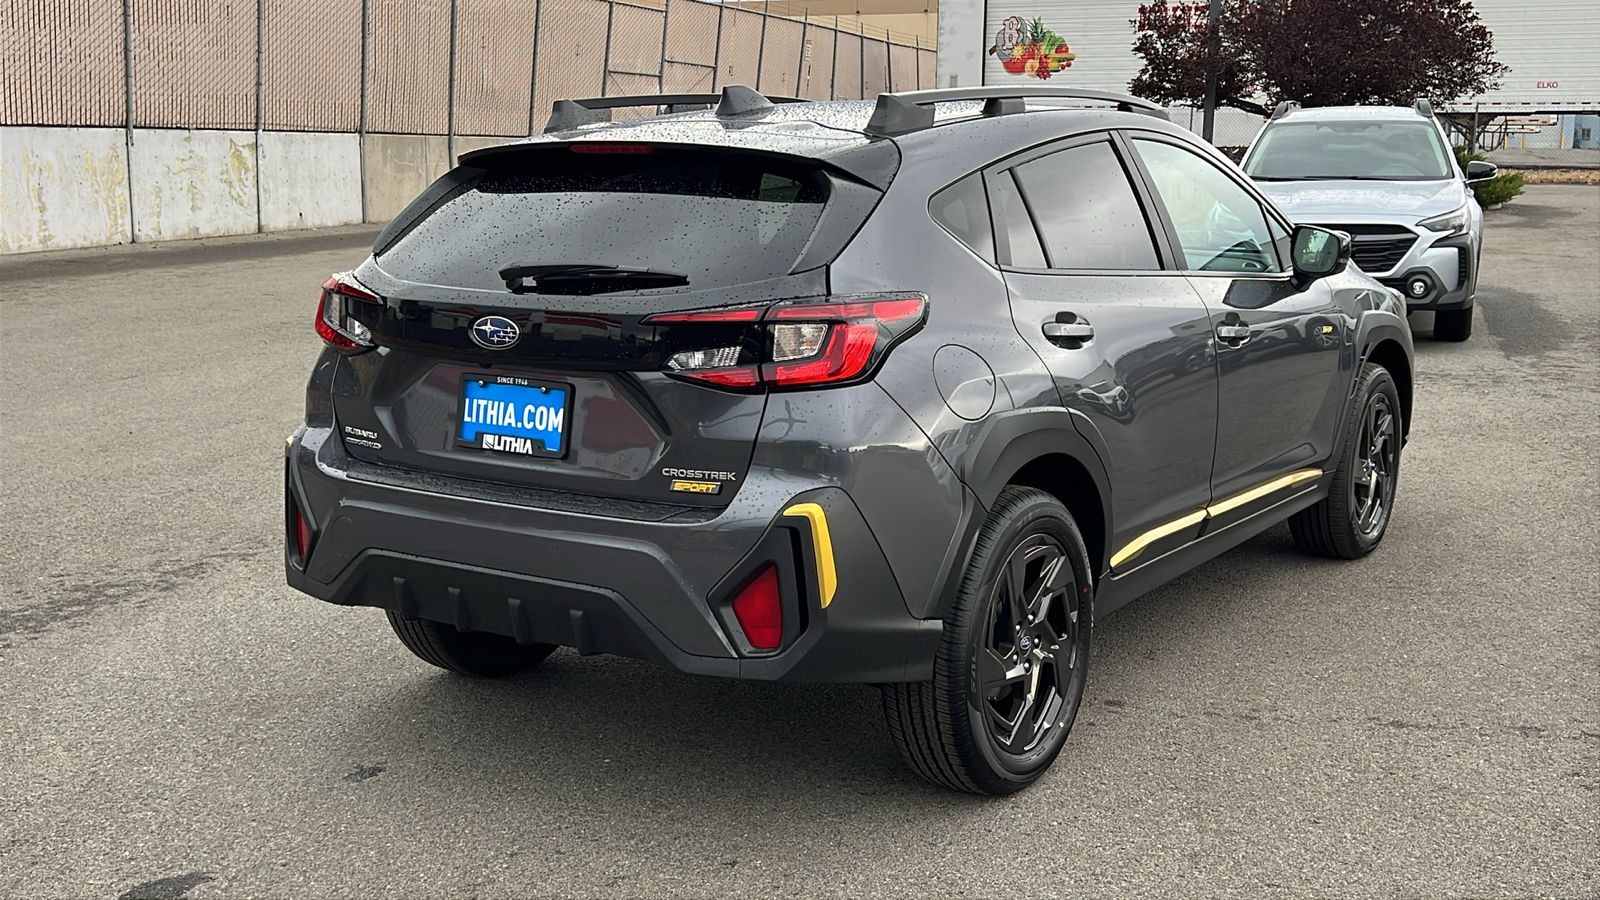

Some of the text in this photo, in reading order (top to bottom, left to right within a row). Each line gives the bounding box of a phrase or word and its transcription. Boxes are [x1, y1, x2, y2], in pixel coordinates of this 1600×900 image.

[1536, 81, 1559, 89] ELKO
[496, 376, 529, 386] SINCE 1946
[463, 397, 564, 433] LITHIA.COM
[494, 434, 533, 455] LITHIA
[661, 467, 737, 481] CROSSTREK
[673, 482, 717, 493] SPORT
